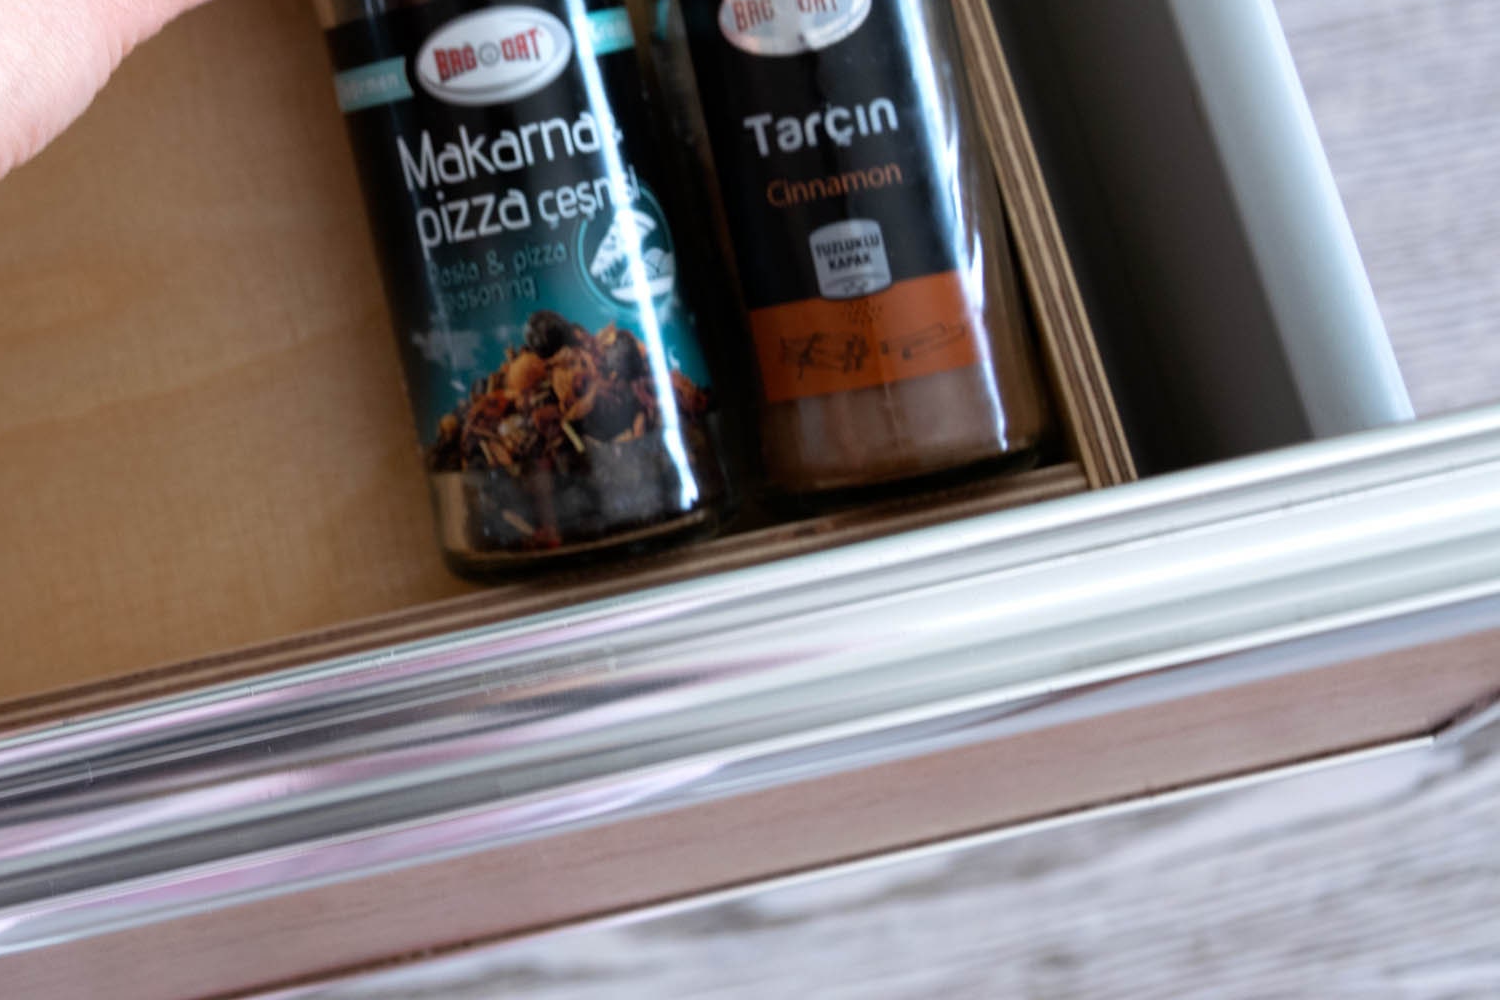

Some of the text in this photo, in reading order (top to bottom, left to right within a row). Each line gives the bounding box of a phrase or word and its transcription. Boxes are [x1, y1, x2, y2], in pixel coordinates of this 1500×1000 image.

[397, 111, 602, 192] Makarna
[743, 97, 899, 157] Tarçın
[766, 162, 904, 208] Cinnamon
[416, 189, 531, 262] pizza
[512, 240, 568, 278] pizza
[828, 252, 873, 272] KAPAK
